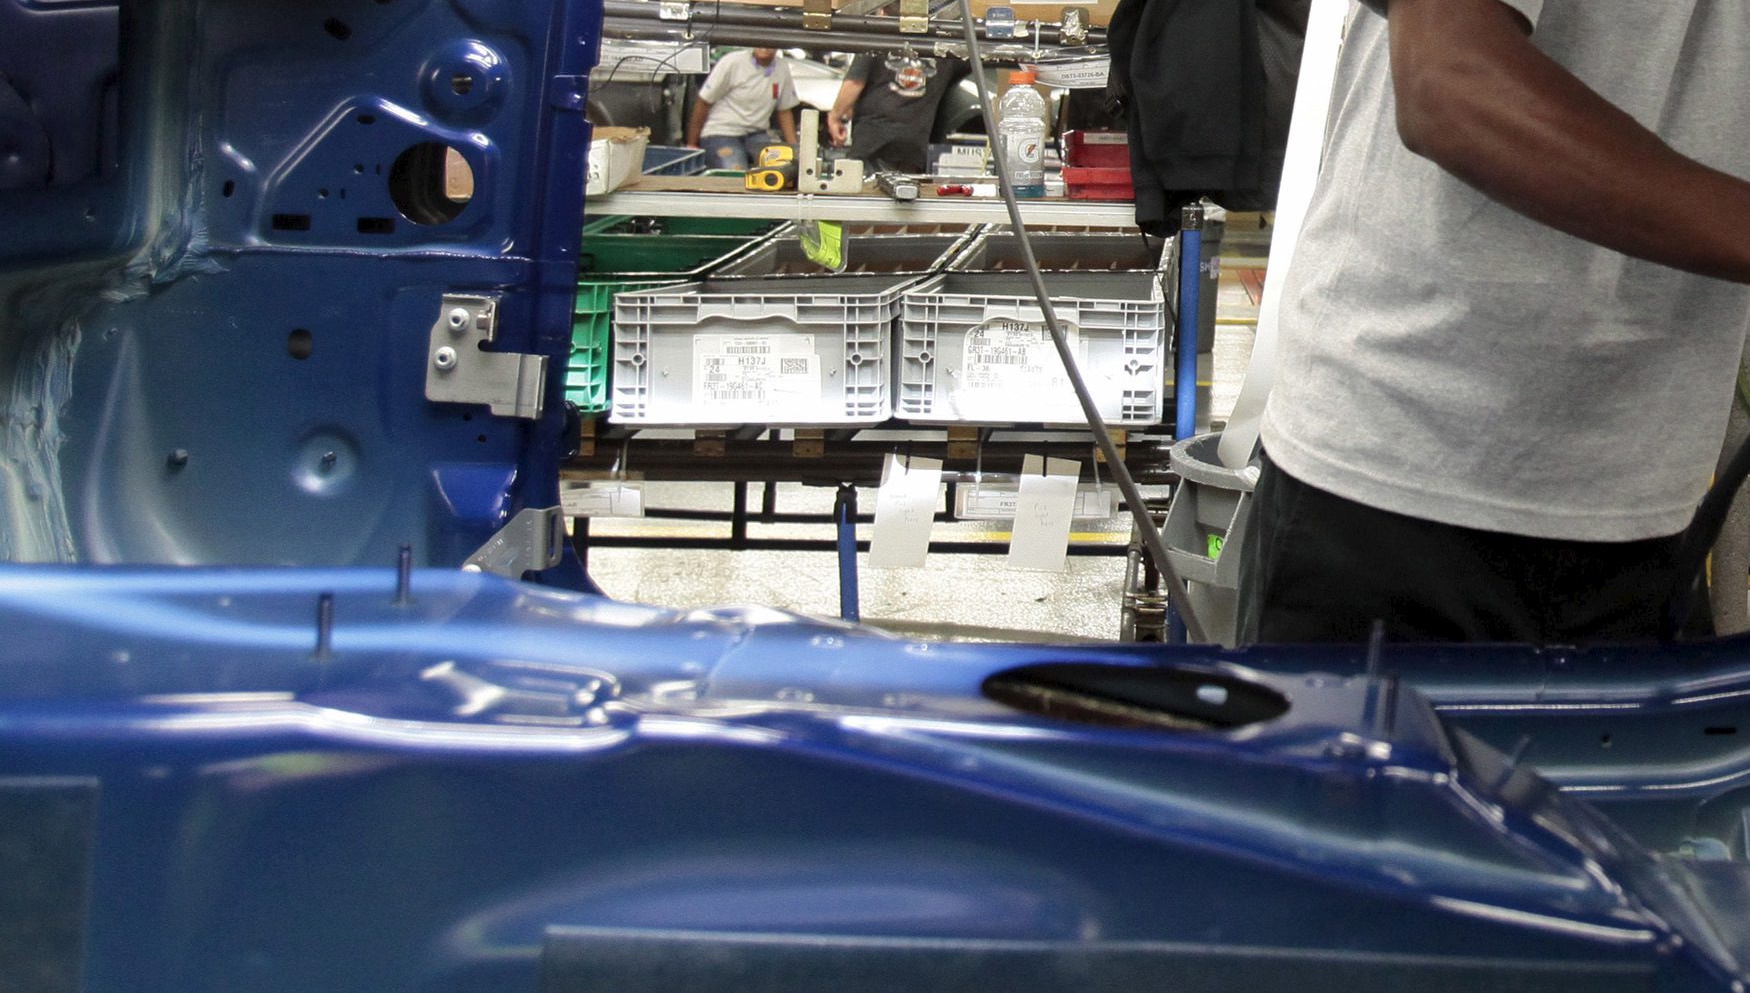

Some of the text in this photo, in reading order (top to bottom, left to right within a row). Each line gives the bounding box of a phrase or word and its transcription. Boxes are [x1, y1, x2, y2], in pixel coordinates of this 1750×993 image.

[1002, 323, 1029, 332] H137J
[738, 357, 766, 366] H137J
[709, 365, 720, 373] 24
